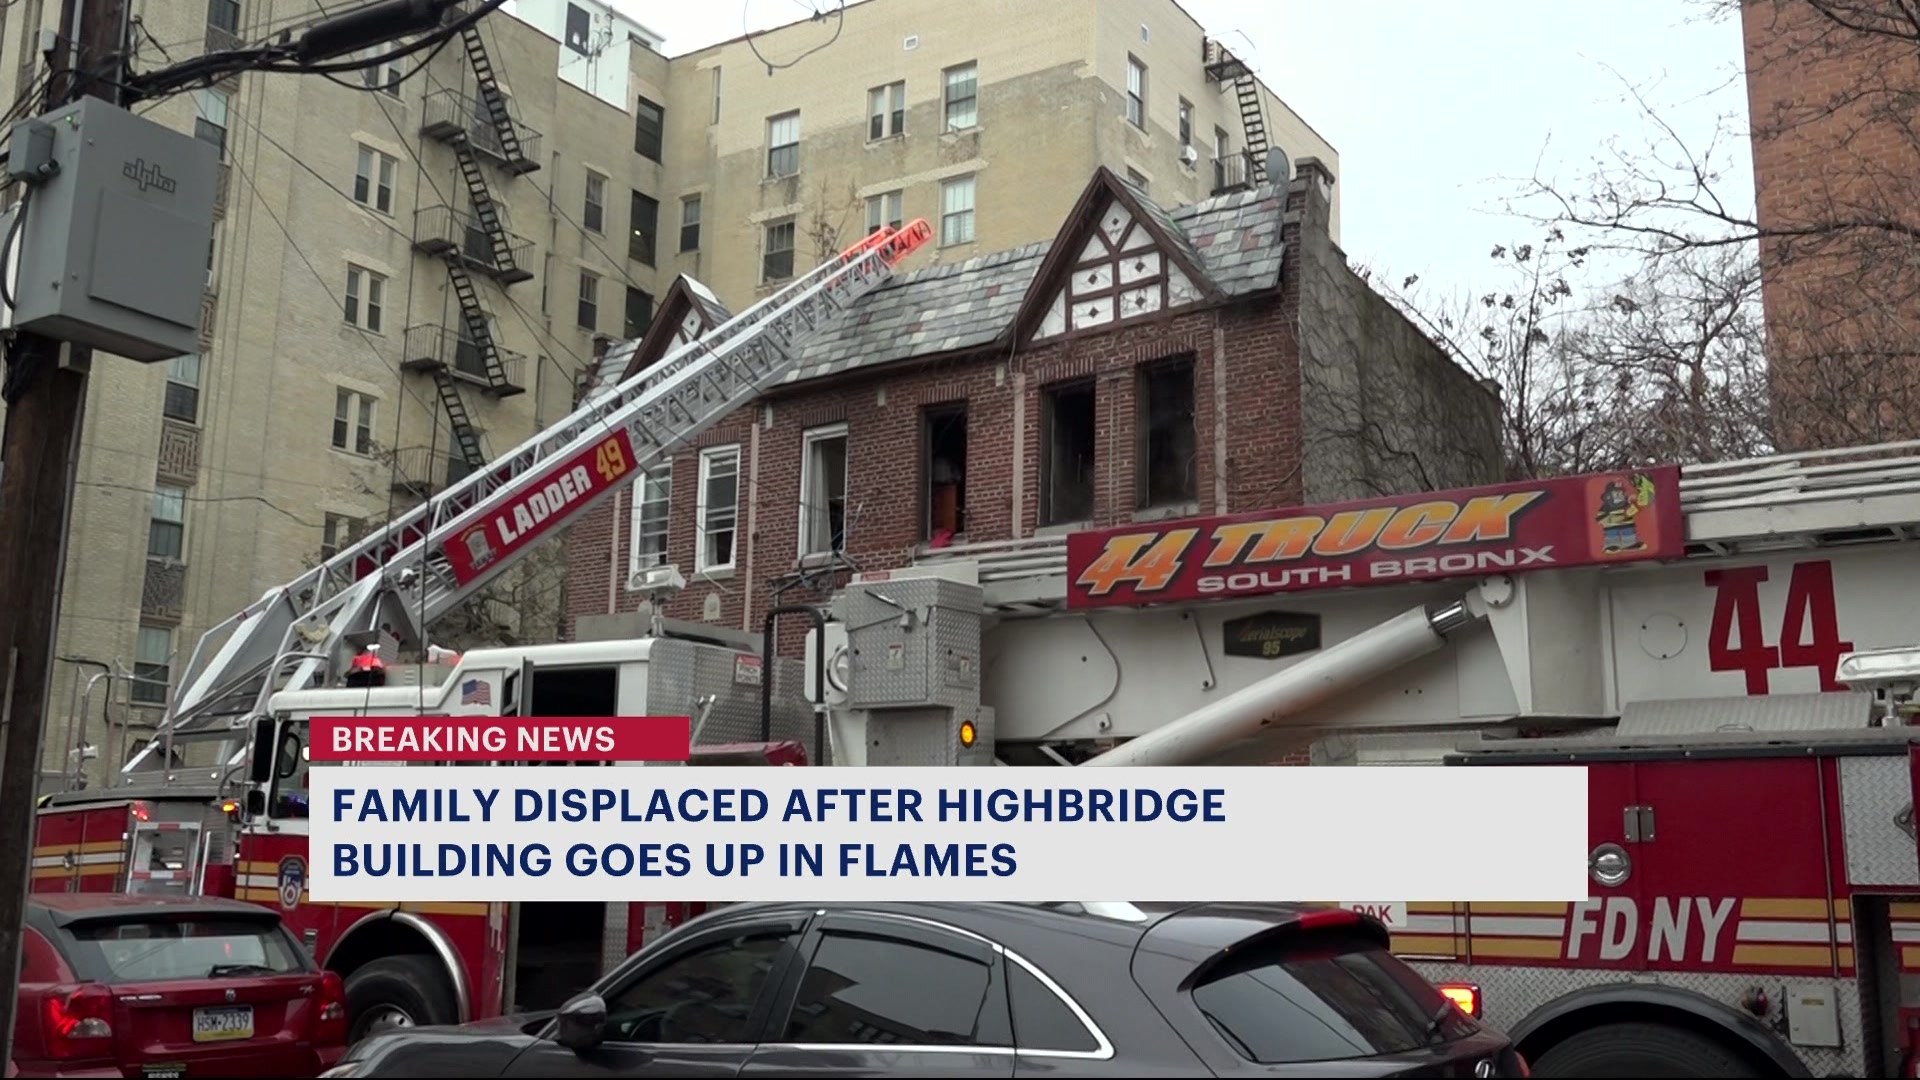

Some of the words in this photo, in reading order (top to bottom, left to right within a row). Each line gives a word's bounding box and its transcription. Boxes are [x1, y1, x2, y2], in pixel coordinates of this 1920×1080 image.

[122, 158, 177, 193] alpha
[496, 465, 593, 545] LADDER
[596, 438, 626, 482] 49
[1075, 528, 1200, 595] 44
[1202, 490, 1546, 567] TRUCK
[1197, 564, 1351, 592] SOUTH
[1370, 545, 1557, 579] BRONX
[1262, 640, 1281, 656] 95
[1704, 559, 1854, 696] 44
[1567, 896, 1736, 962] FDNY
